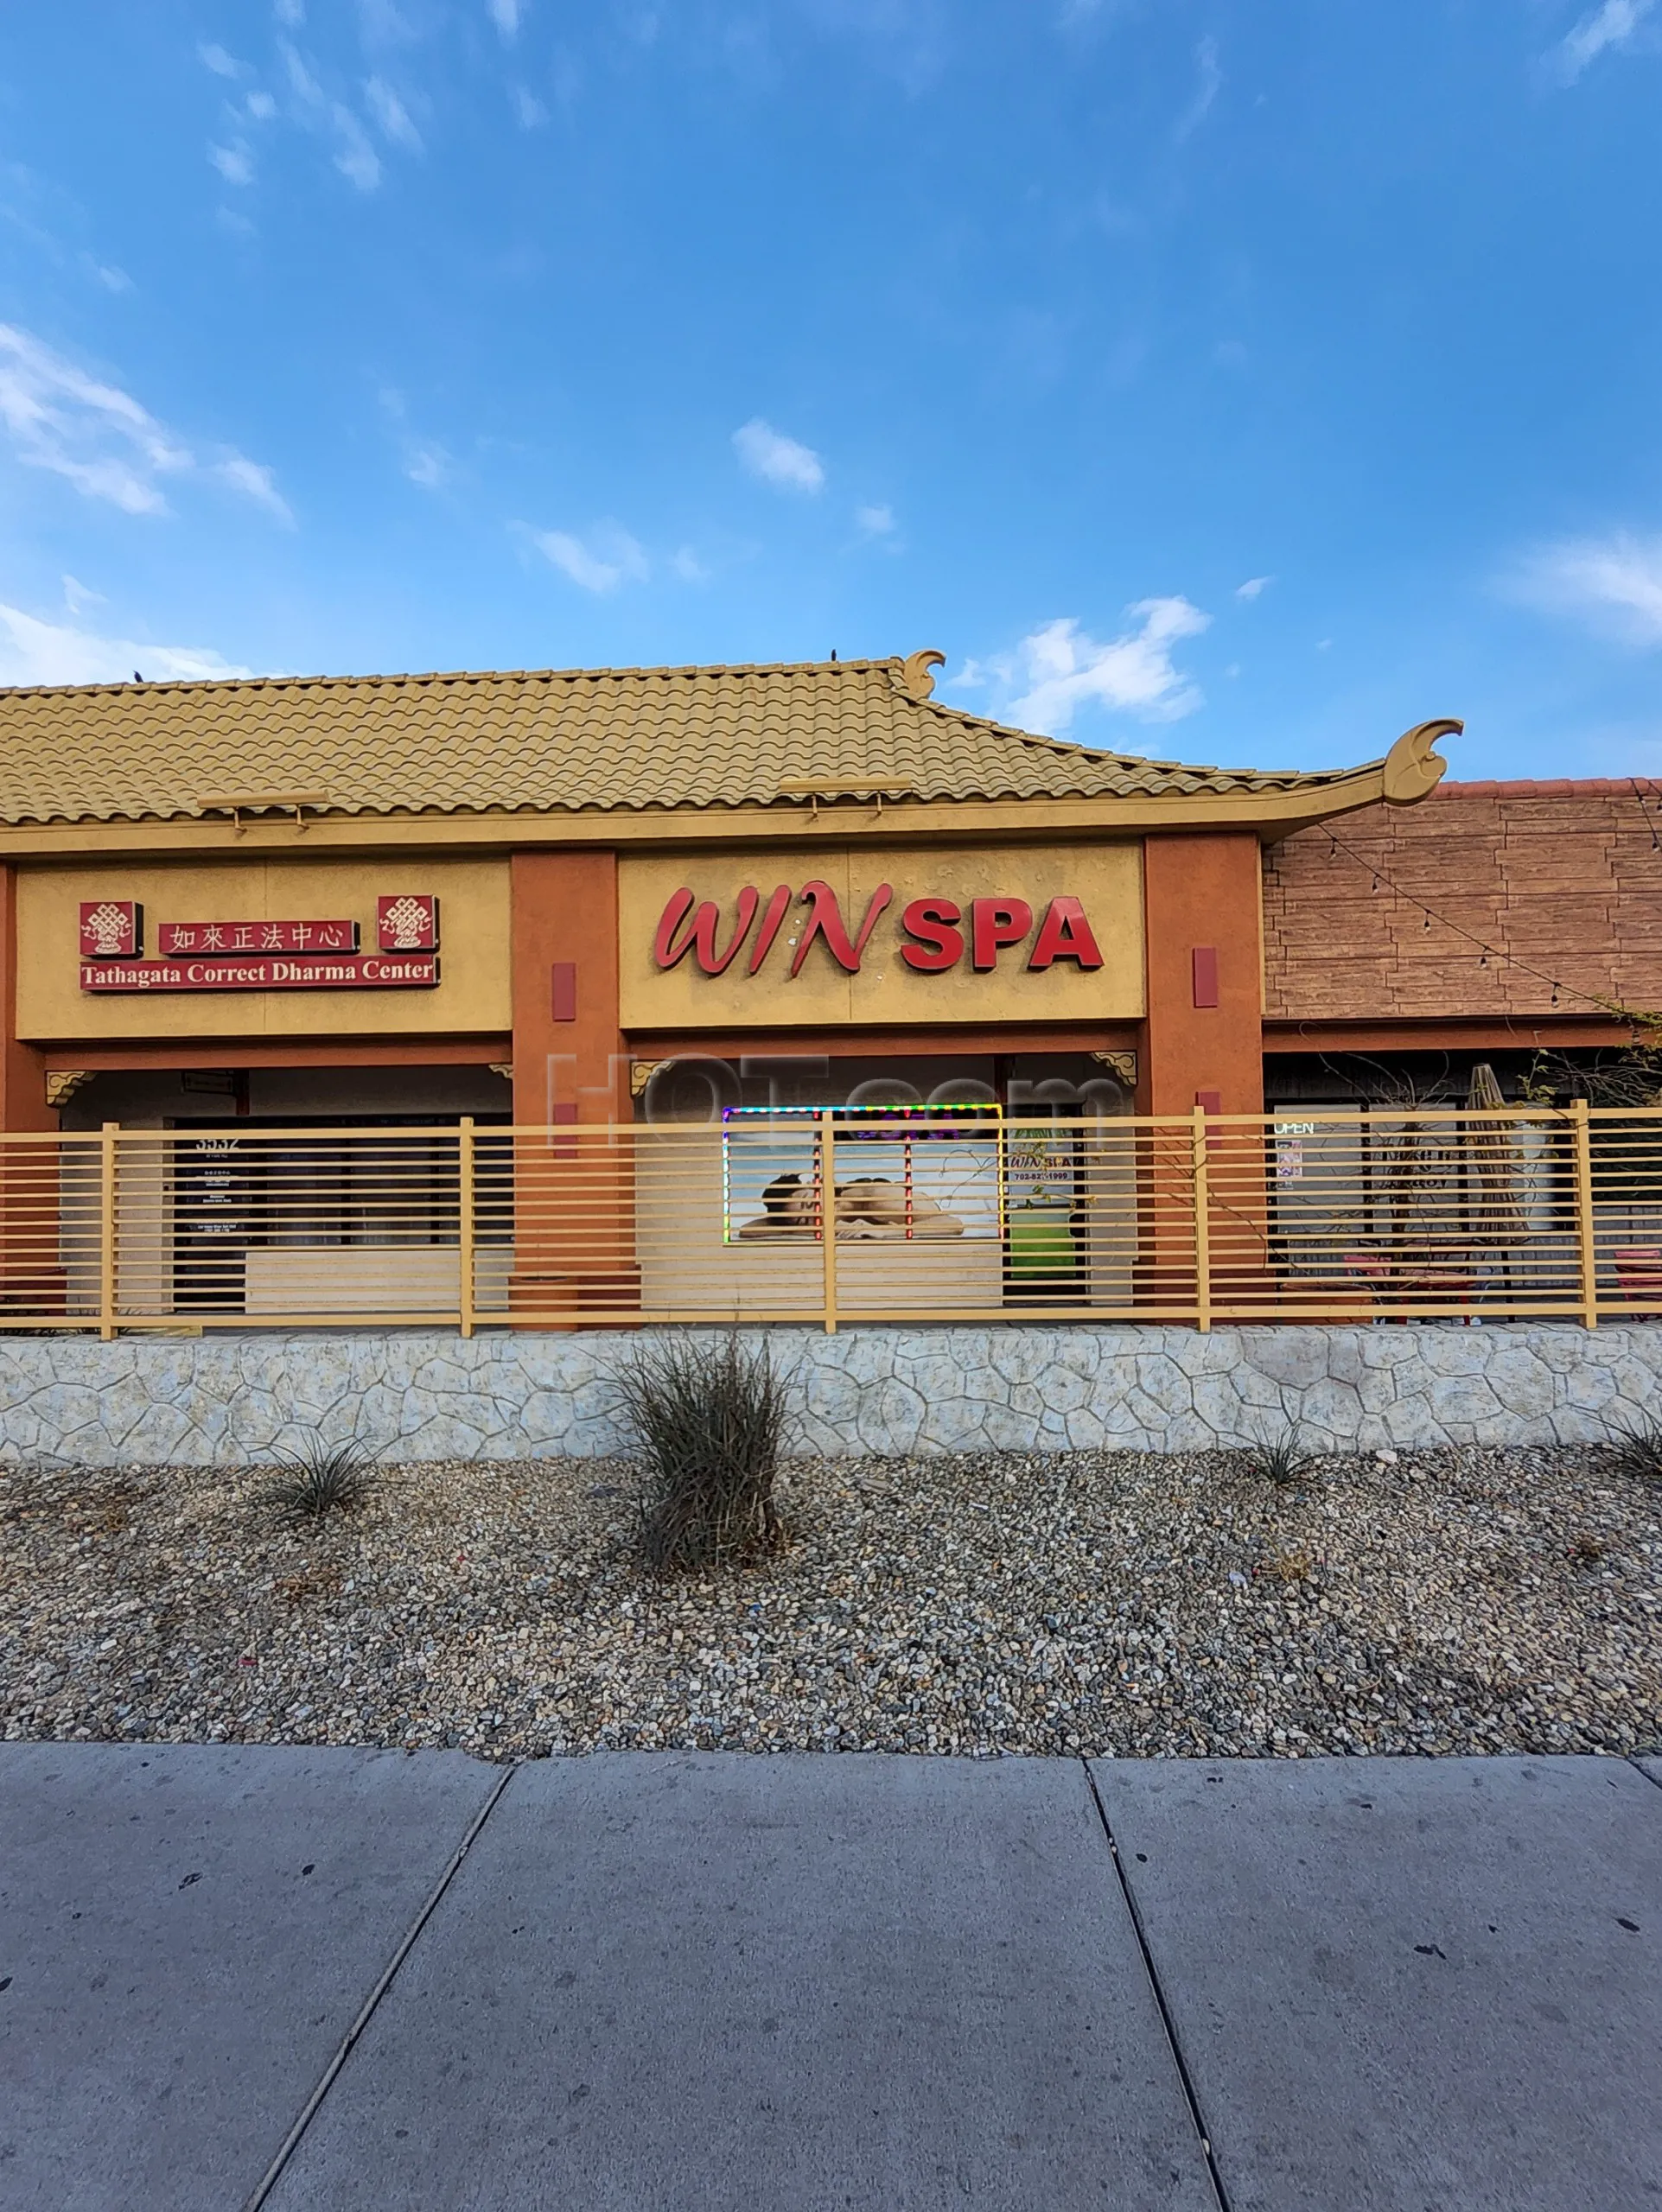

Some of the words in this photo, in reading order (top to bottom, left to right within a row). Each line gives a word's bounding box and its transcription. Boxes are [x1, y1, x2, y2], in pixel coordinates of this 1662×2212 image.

[169, 924, 344, 951] 如來正法中心
[653, 880, 893, 978] WIN
[900, 896, 1105, 972] SPA
[81, 965, 181, 988] Tathagata
[187, 963, 265, 982] Correct
[271, 962, 357, 981] Dharma
[362, 960, 434, 979] Center
[1274, 1122, 1314, 1134] OPEN
